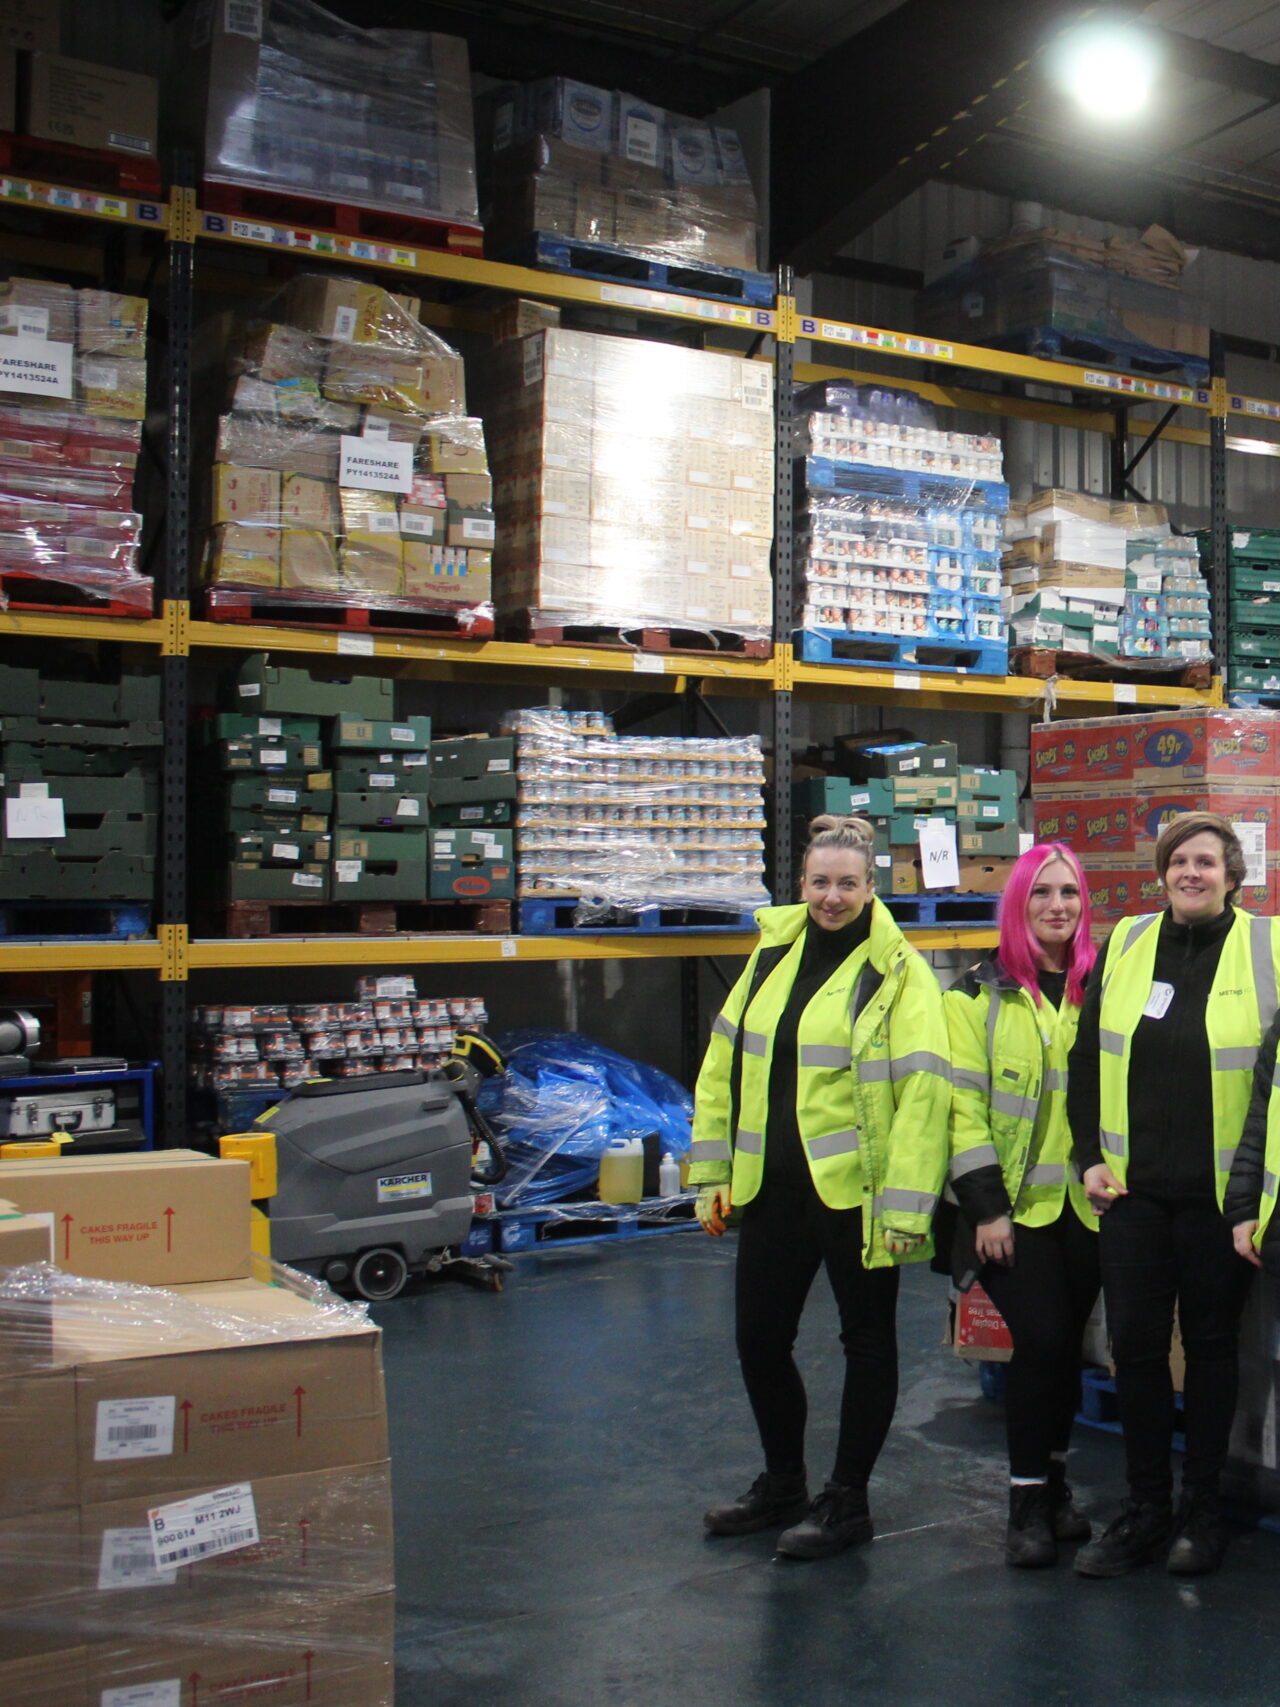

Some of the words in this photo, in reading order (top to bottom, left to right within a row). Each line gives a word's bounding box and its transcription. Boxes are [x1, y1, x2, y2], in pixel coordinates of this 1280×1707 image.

[139, 203, 158, 220] B
[206, 215, 225, 232] B
[756, 312, 771, 326] B
[802, 320, 816, 333] B
[1197, 391, 1209, 403] B
[1231, 397, 1242, 409] B
[346, 456, 400, 469] FARESHARE
[346, 468, 400, 481] PY1413524A
[1157, 734, 1183, 755] 49p
[929, 849, 948, 863] N/R
[80, 1224, 114, 1234] CAKES
[117, 1221, 158, 1231] FRAGILE
[89, 1235, 110, 1245] THIS
[114, 1233, 133, 1243] WAY
[137, 1232, 150, 1241] UP
[968, 1306, 984, 1318] Tree
[972, 1317, 999, 1330] Display
[200, 1409, 240, 1422] CAKES
[241, 1402, 288, 1416] FRAGILE
[154, 1518, 165, 1531] B
[194, 1512, 216, 1525] M11
[219, 1504, 241, 1518] 2WJ
[157, 1534, 176, 1547] 900
